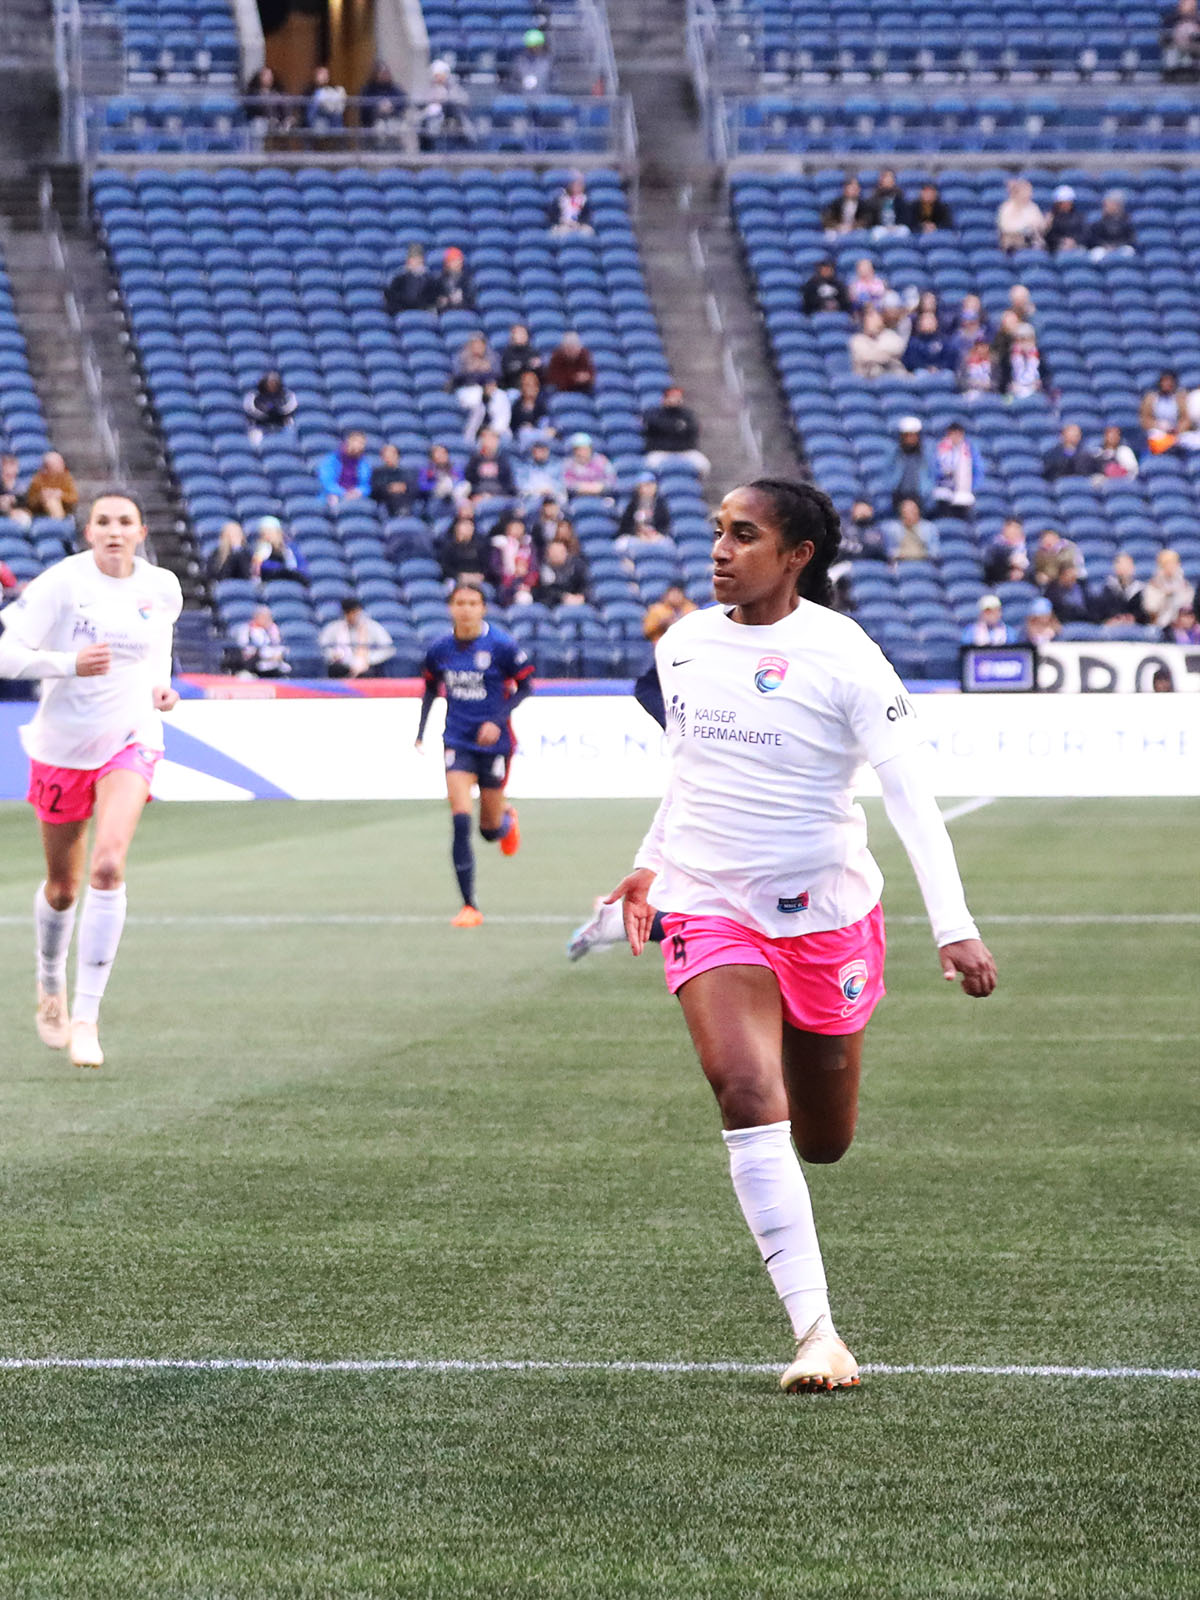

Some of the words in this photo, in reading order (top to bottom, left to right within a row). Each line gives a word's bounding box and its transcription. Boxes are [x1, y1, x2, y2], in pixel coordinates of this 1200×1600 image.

[694, 708, 736, 724] KAISER
[886, 694, 917, 722] ally
[516, 732, 600, 758] MS
[693, 725, 783, 747] PERMANENTE
[36, 778, 64, 814] 22
